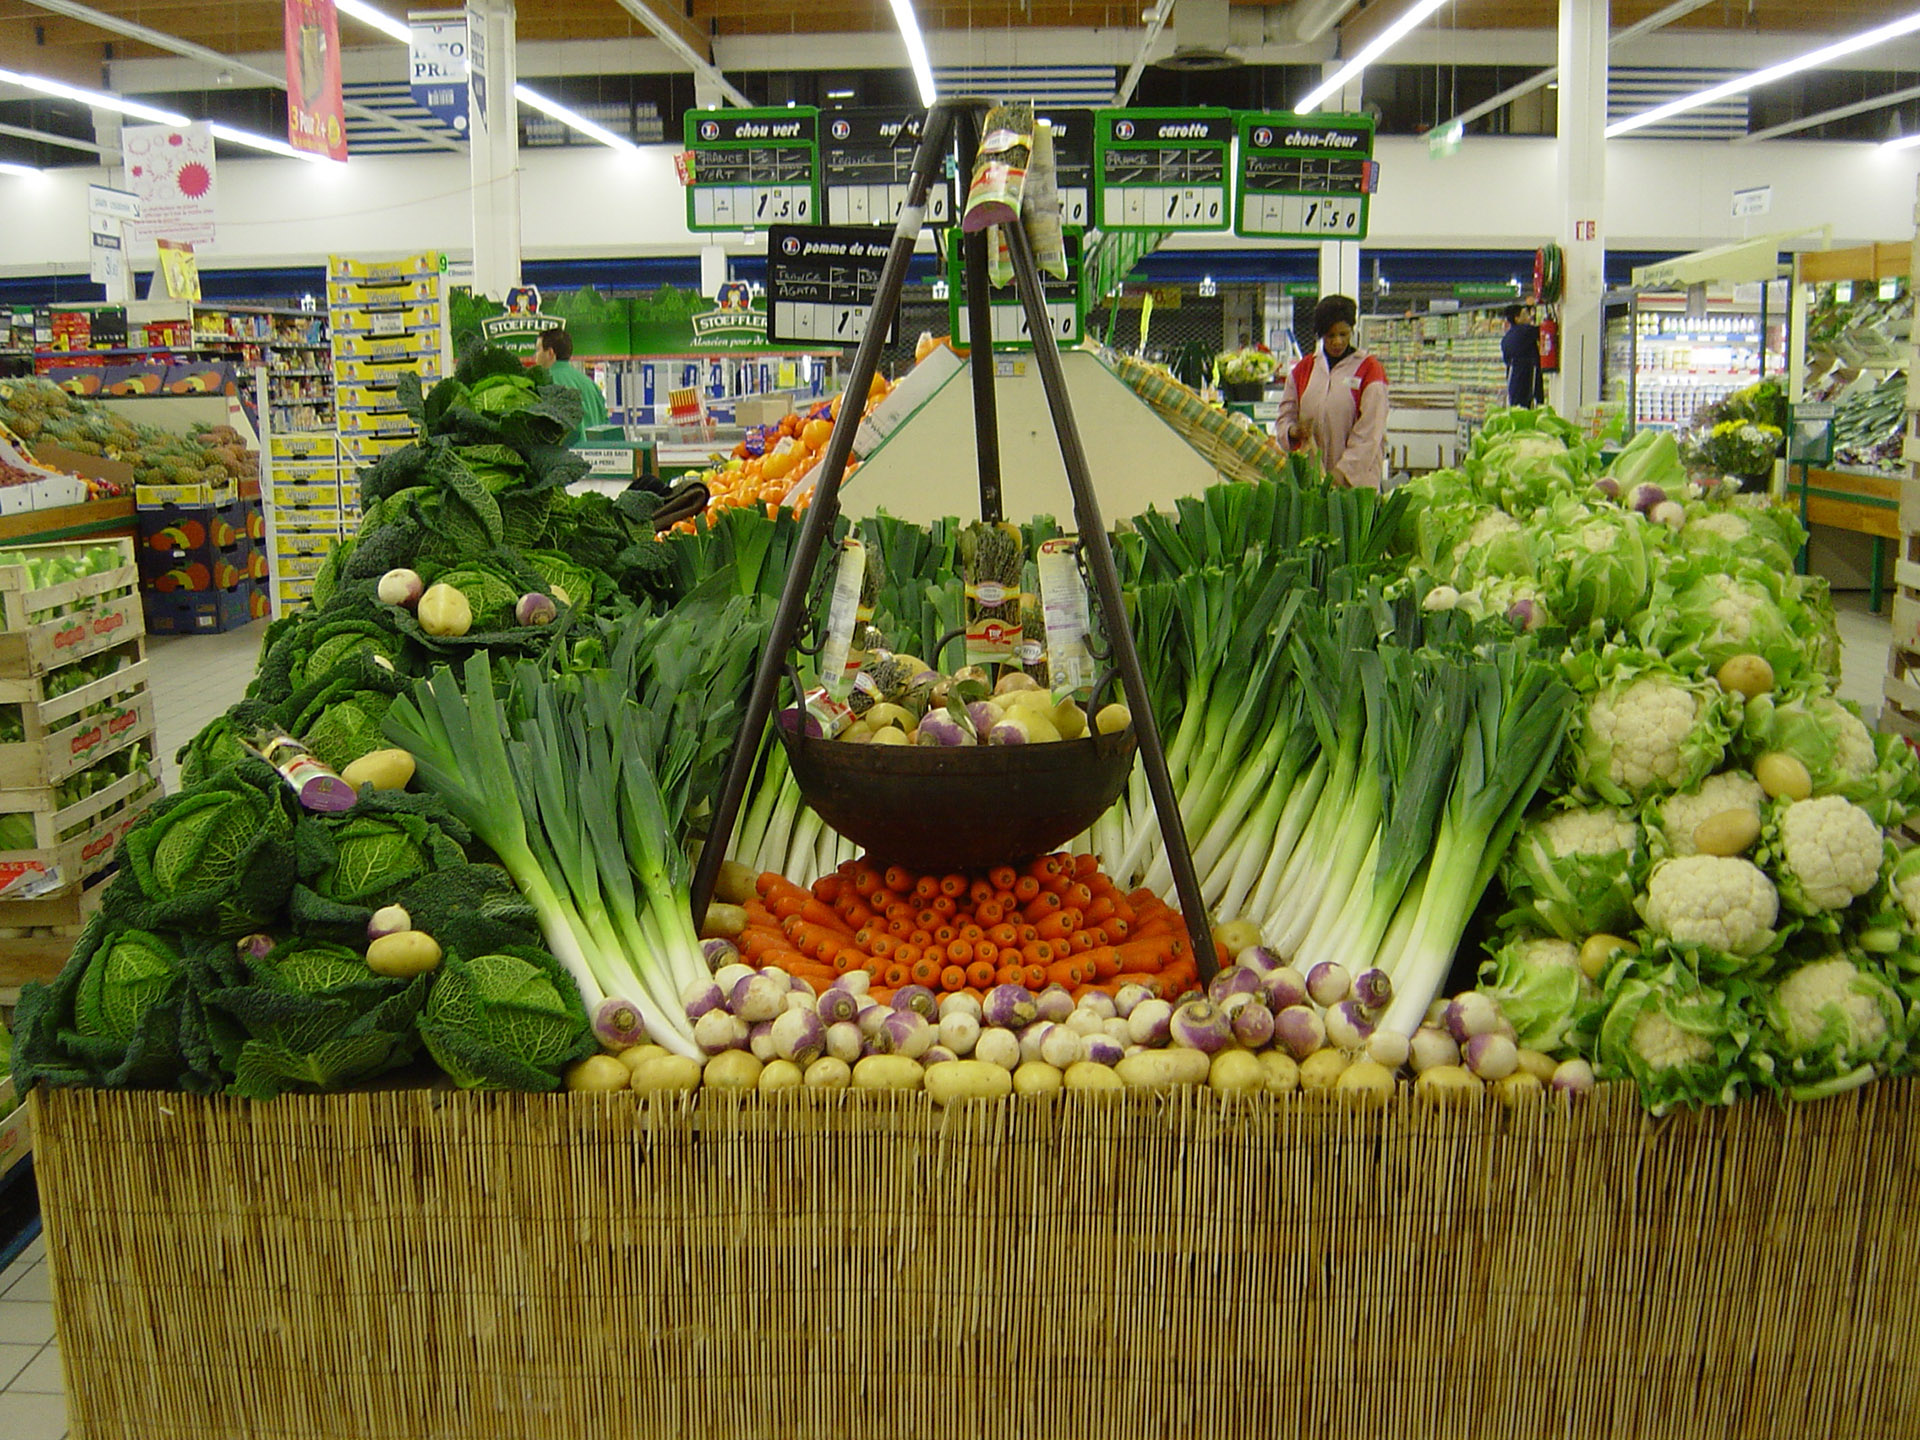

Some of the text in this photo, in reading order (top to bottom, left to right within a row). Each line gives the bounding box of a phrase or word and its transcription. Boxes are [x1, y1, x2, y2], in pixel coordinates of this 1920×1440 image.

[735, 122, 800, 138] chou vert
[1158, 123, 1208, 138] carotte
[1285, 131, 1358, 148] chou-fleur
[803, 242, 890, 257] pomme de terr
[440, 256, 448, 273] 9
[936, 288, 946, 297] 17
[1201, 284, 1214, 294] 20
